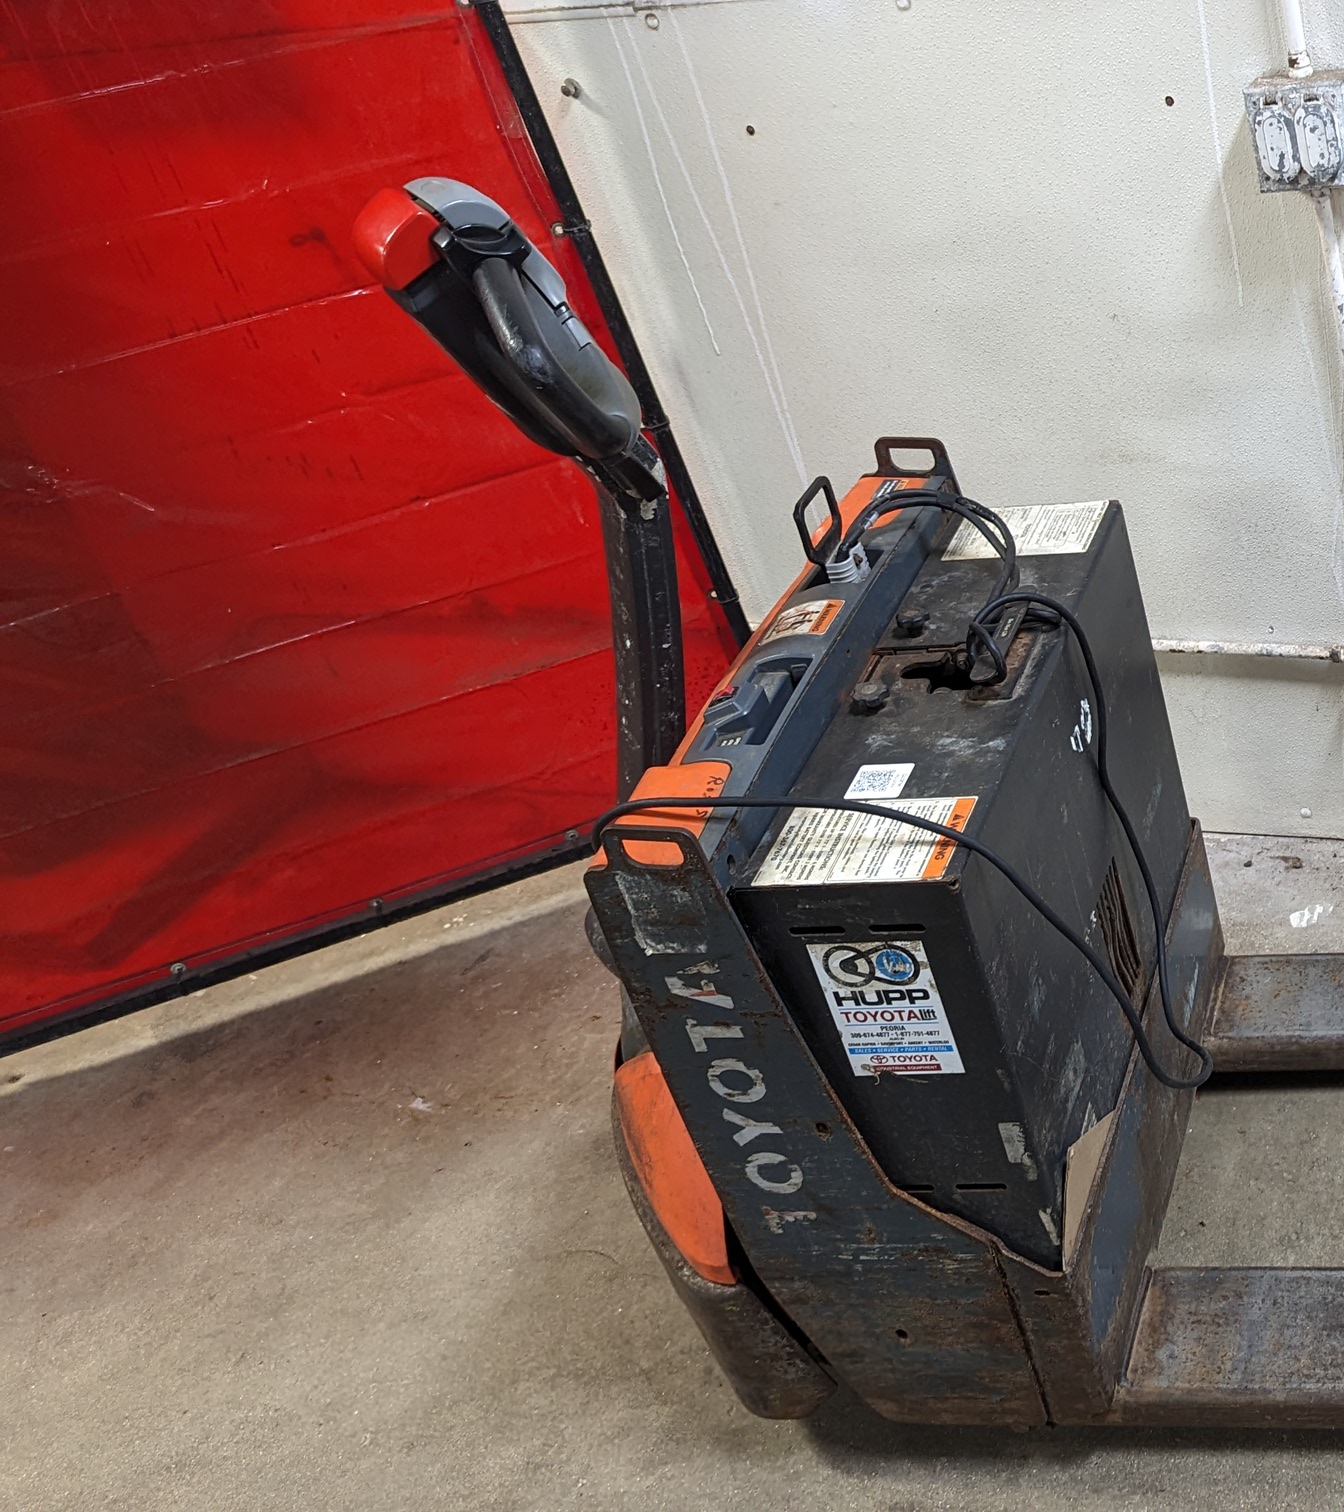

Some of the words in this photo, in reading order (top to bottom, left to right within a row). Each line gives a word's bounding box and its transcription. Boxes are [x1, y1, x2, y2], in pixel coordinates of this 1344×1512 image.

[812, 608, 831, 631] WARNING
[934, 821, 957, 860] WNING
[832, 989, 930, 1006] HUPP
[889, 1054, 938, 1062] TOYOTA
[664, 961, 817, 1233] TOYOTA
